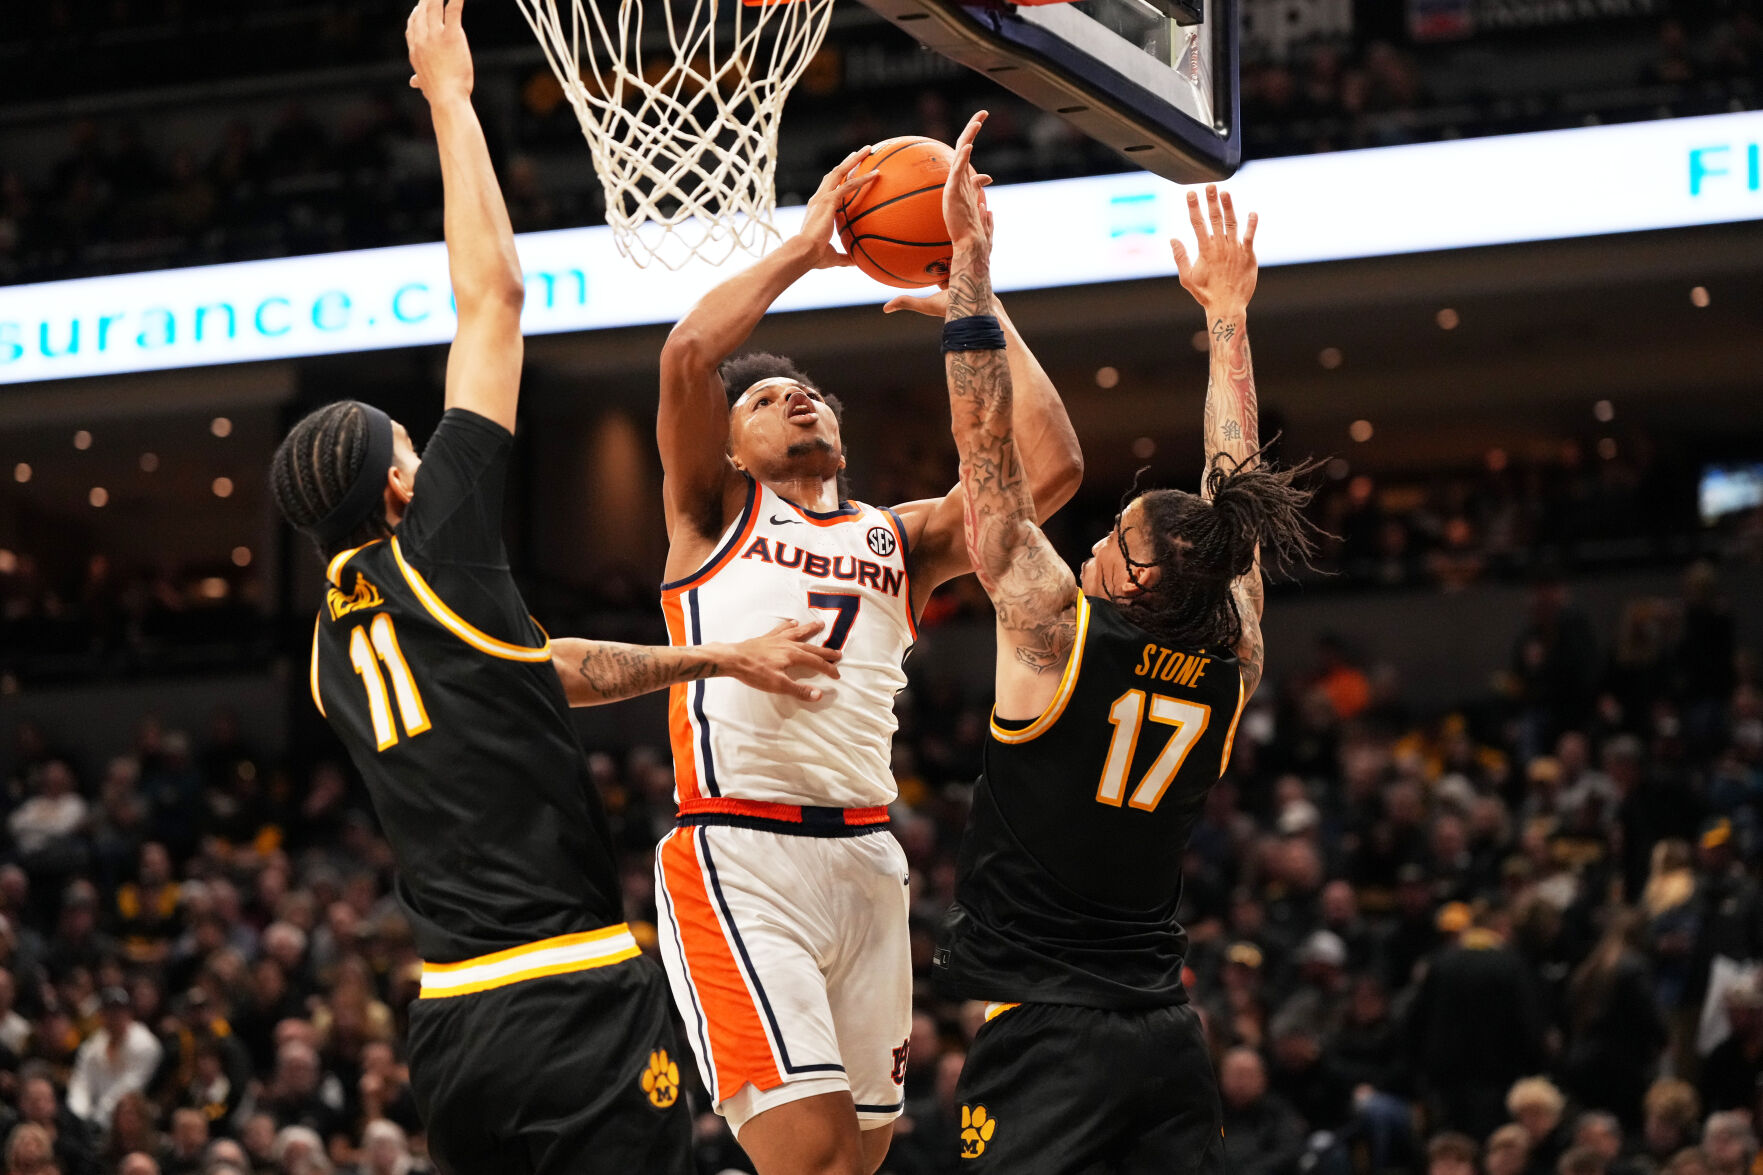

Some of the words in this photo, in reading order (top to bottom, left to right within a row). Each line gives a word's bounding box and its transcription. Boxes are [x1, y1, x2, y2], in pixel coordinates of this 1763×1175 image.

[0, 267, 587, 365] surance.cm
[741, 536, 905, 598] AUBURN
[868, 528, 894, 555] SEC
[807, 591, 861, 651] 7
[349, 611, 432, 752] 11
[1134, 643, 1211, 688] STONE
[1096, 688, 1211, 812] 17
[656, 1086, 672, 1102] M
[960, 1139, 980, 1154] M
